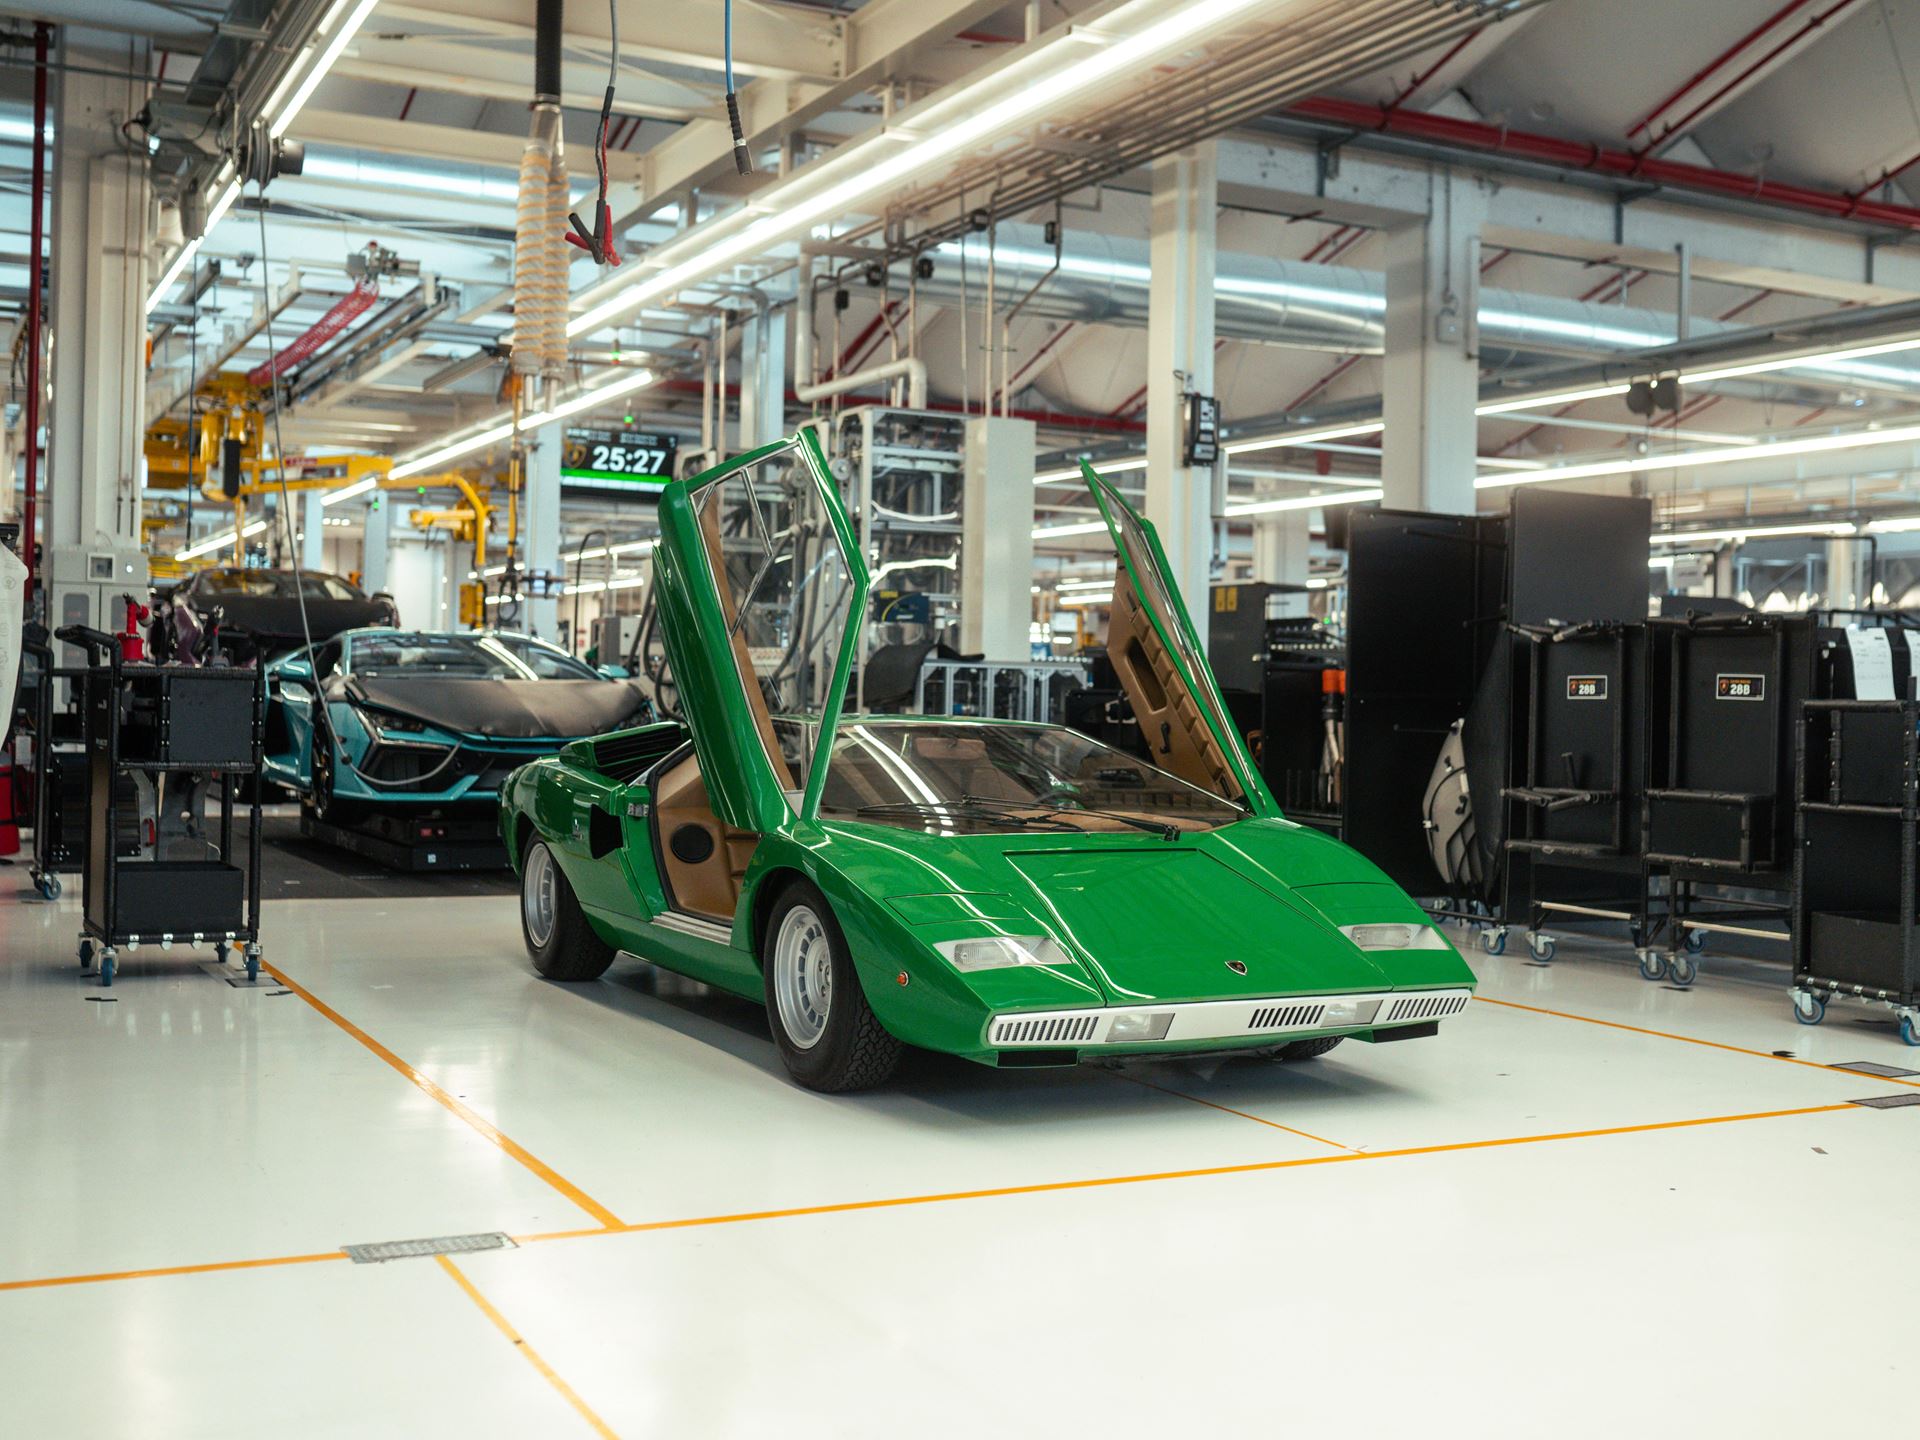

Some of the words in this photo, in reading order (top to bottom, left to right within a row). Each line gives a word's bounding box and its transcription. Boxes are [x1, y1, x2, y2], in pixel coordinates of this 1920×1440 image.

[592, 445, 666, 474] 25:27
[1578, 684, 1596, 695] 28B
[1730, 683, 1751, 695] 28B
